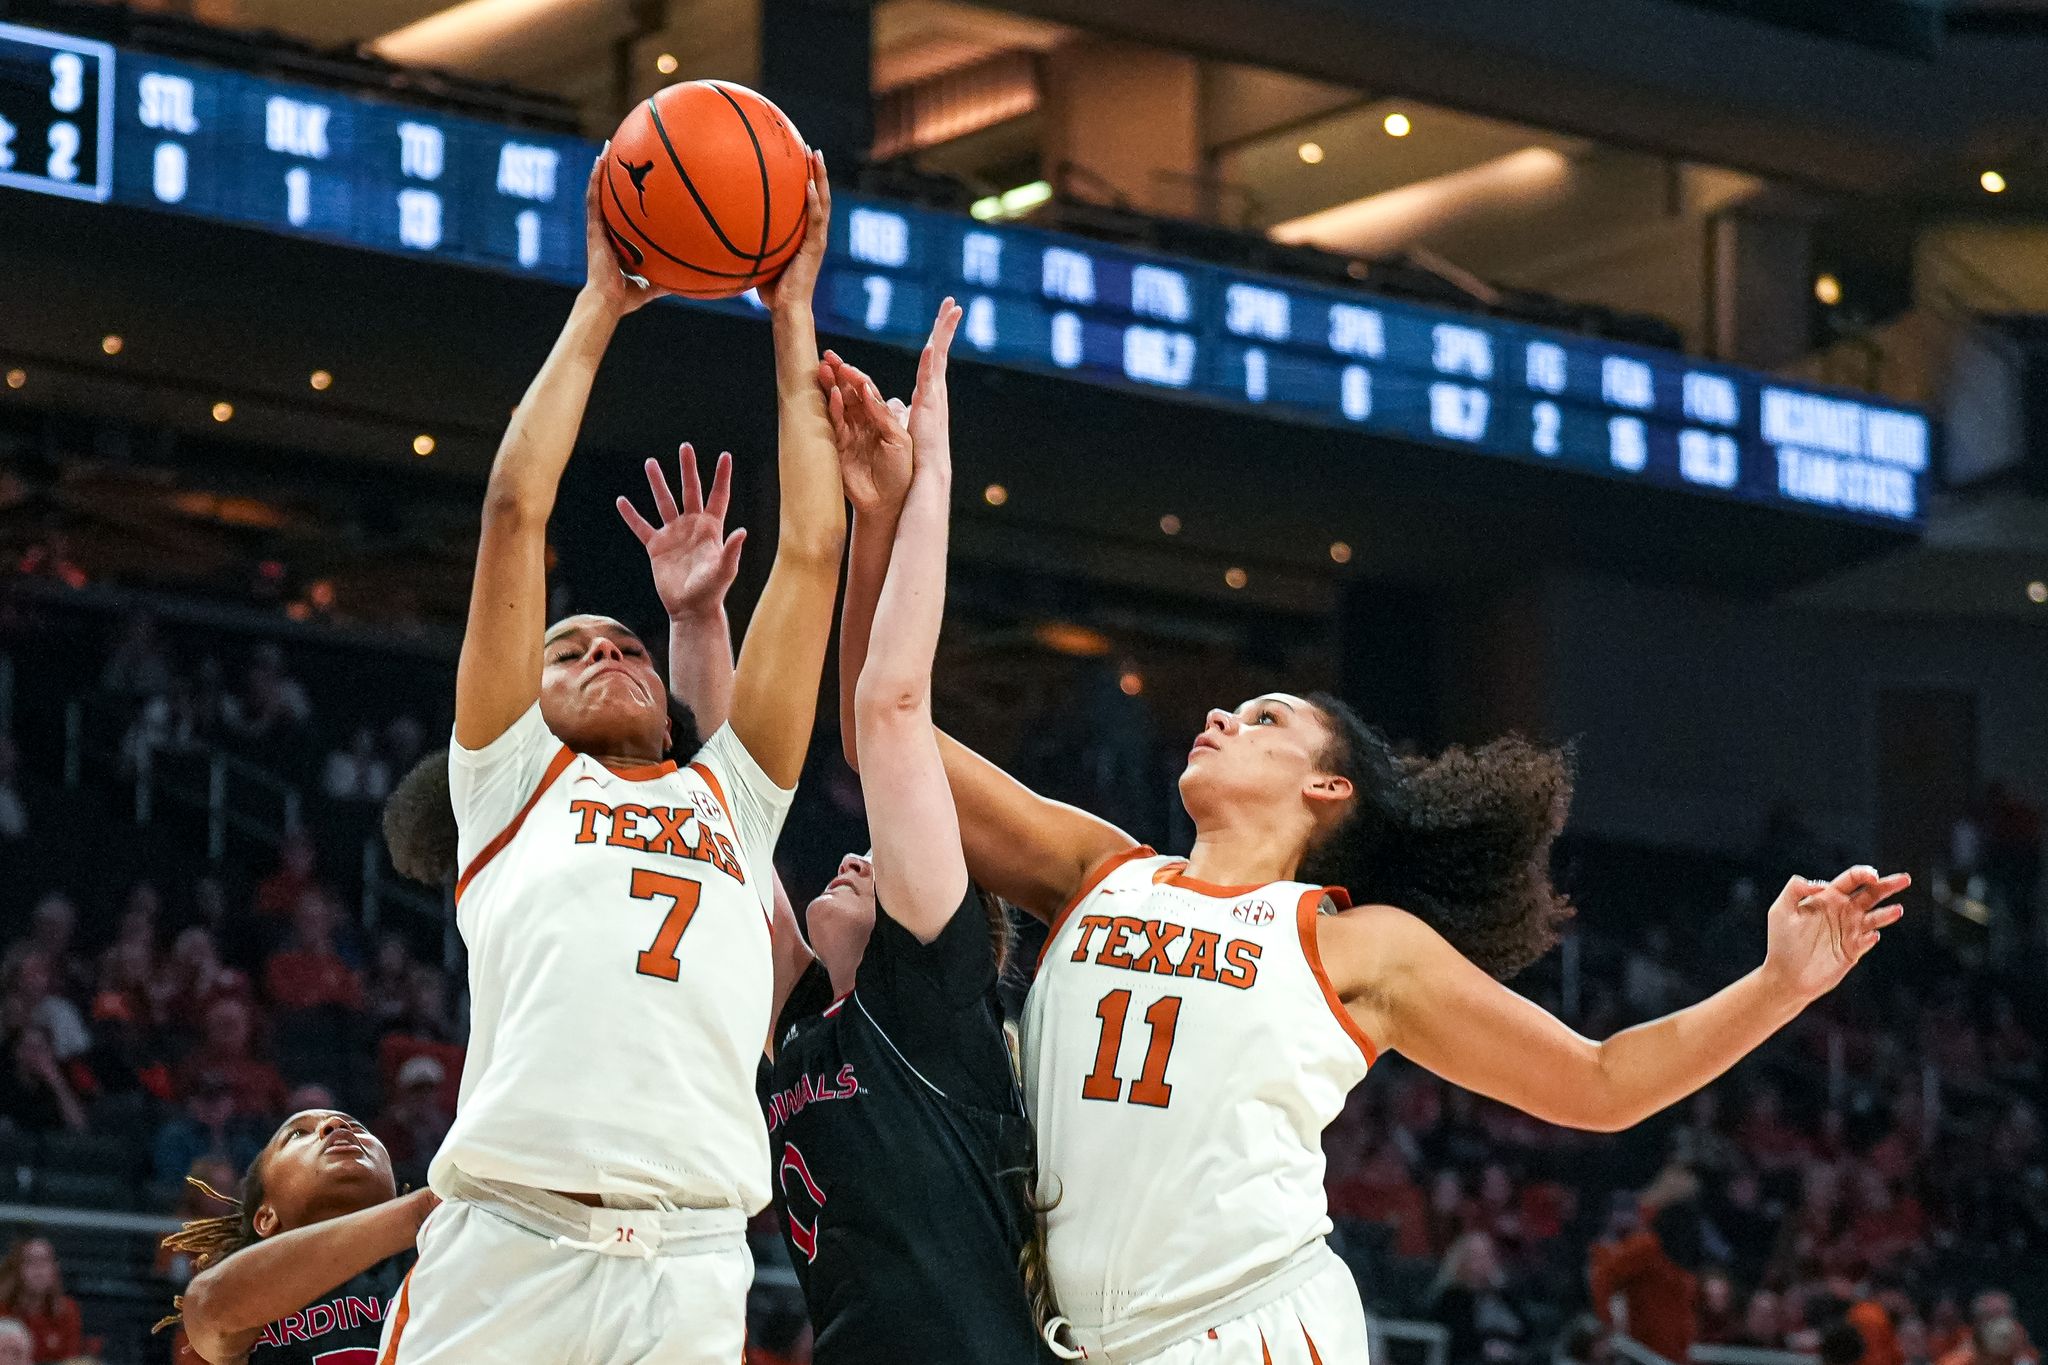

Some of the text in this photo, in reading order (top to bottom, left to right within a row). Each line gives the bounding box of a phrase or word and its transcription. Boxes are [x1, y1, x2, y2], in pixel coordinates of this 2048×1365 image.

[138, 72, 196, 134] STL
[47, 122, 79, 182] 2
[286, 168, 310, 224] 1
[517, 211, 540, 266] 1
[864, 275, 892, 330] 7
[1244, 348, 1268, 400] 1
[1533, 402, 1560, 455] 2
[570, 799, 745, 885] TEXAS
[630, 867, 702, 982] 7
[1070, 915, 1263, 990] TEXAS
[1081, 988, 1183, 1109] 11
[251, 1296, 394, 1352] ARDIN
